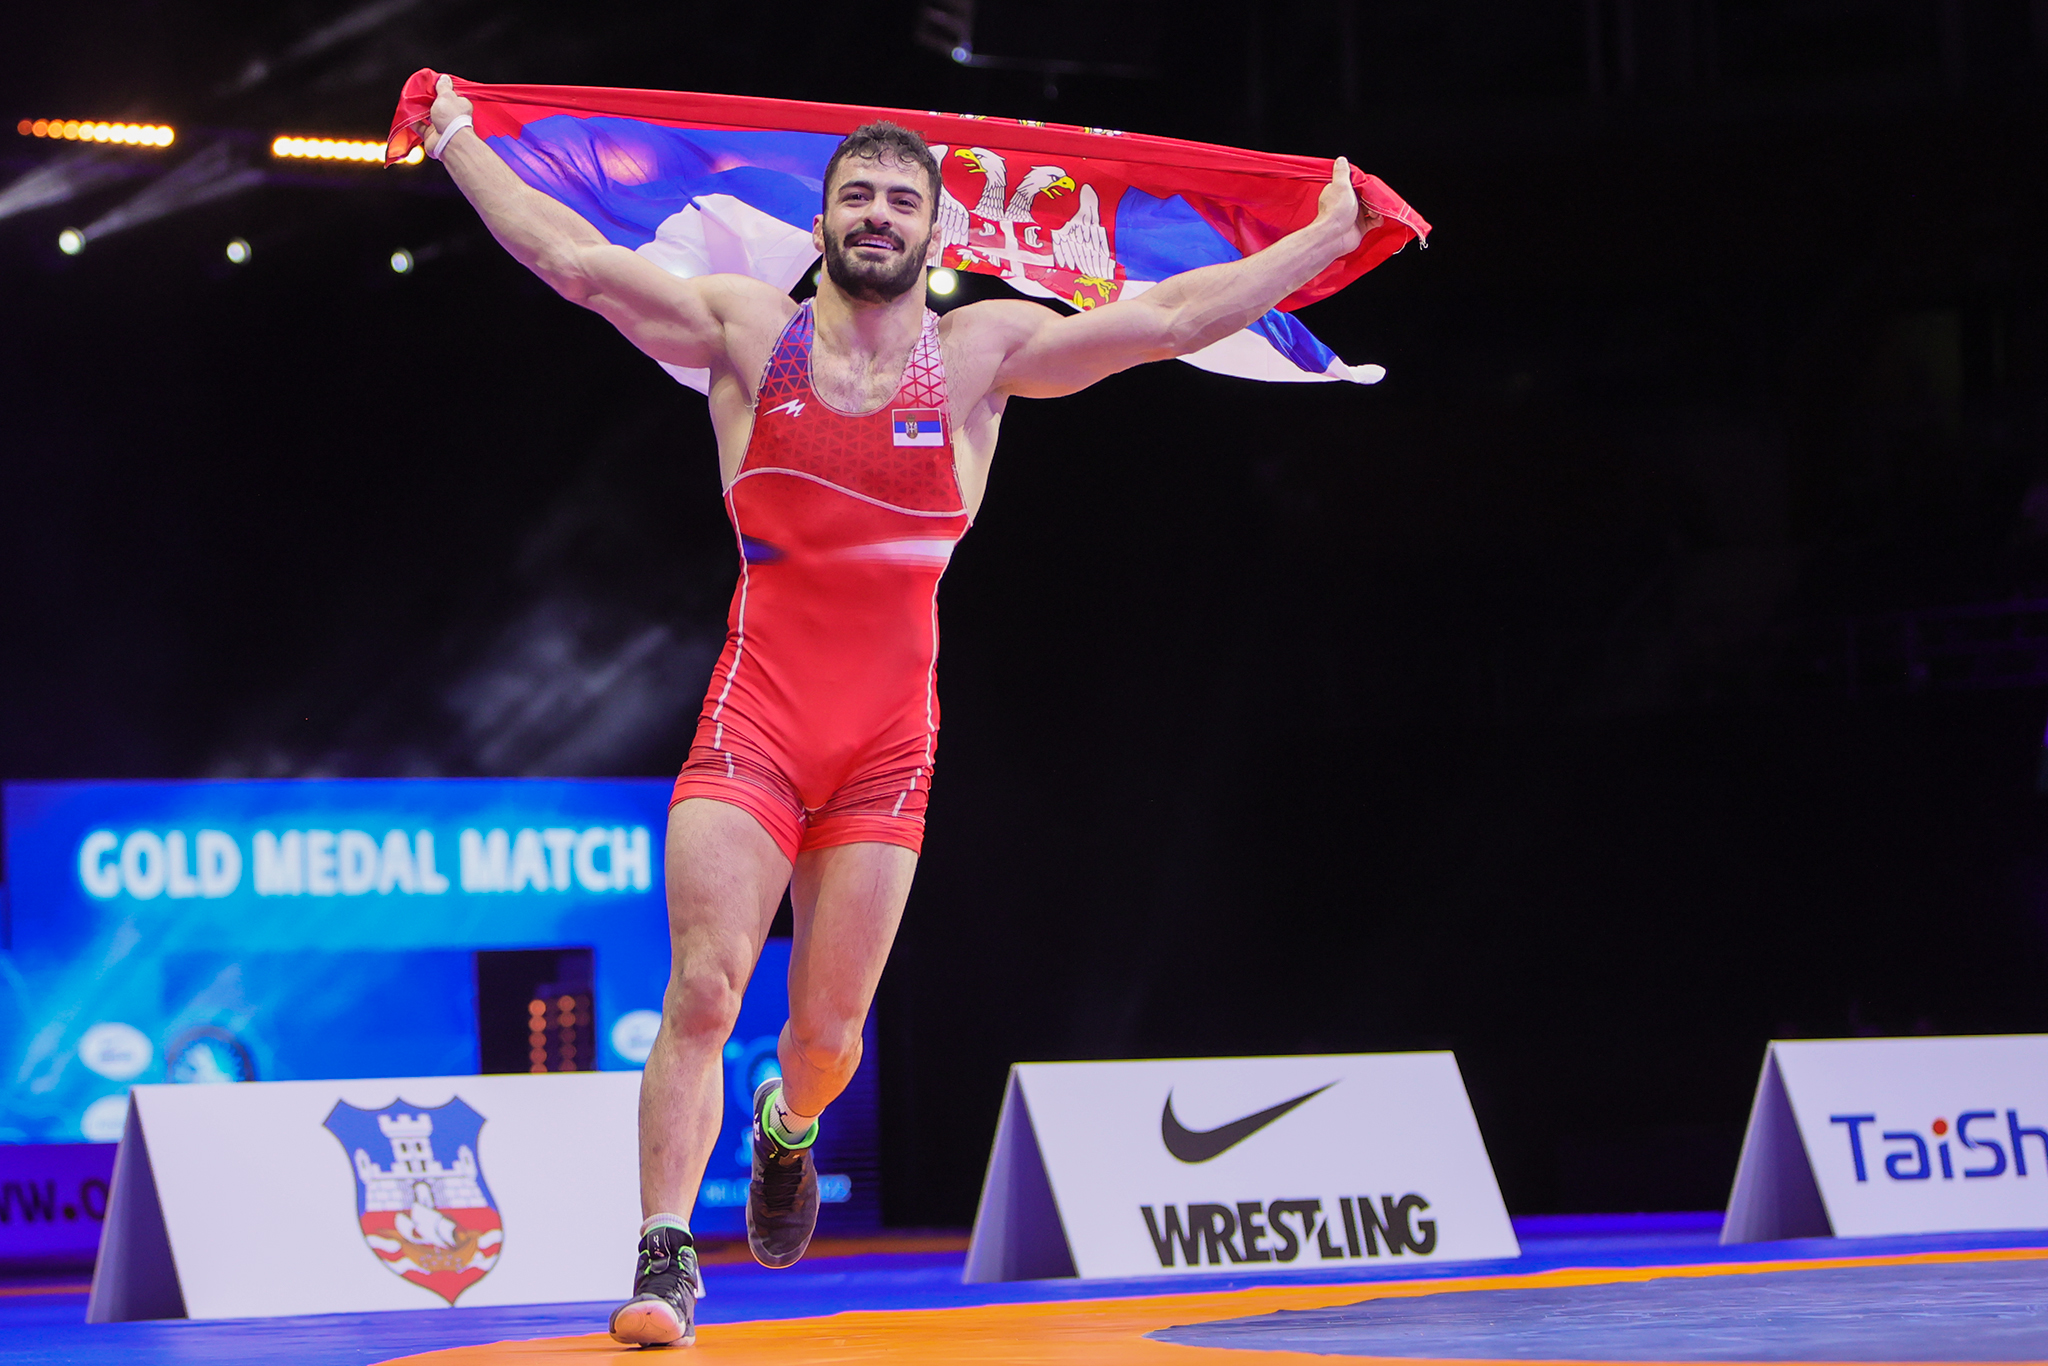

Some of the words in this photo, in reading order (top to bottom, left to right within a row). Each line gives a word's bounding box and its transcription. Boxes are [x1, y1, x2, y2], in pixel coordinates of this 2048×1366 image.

[79, 828, 243, 900] GOLD
[251, 828, 450, 897] MEDAL
[459, 826, 652, 894] MATCH
[1829, 1108, 2048, 1182] TaiSh
[1140, 1194, 1438, 1267] WRESTLING
